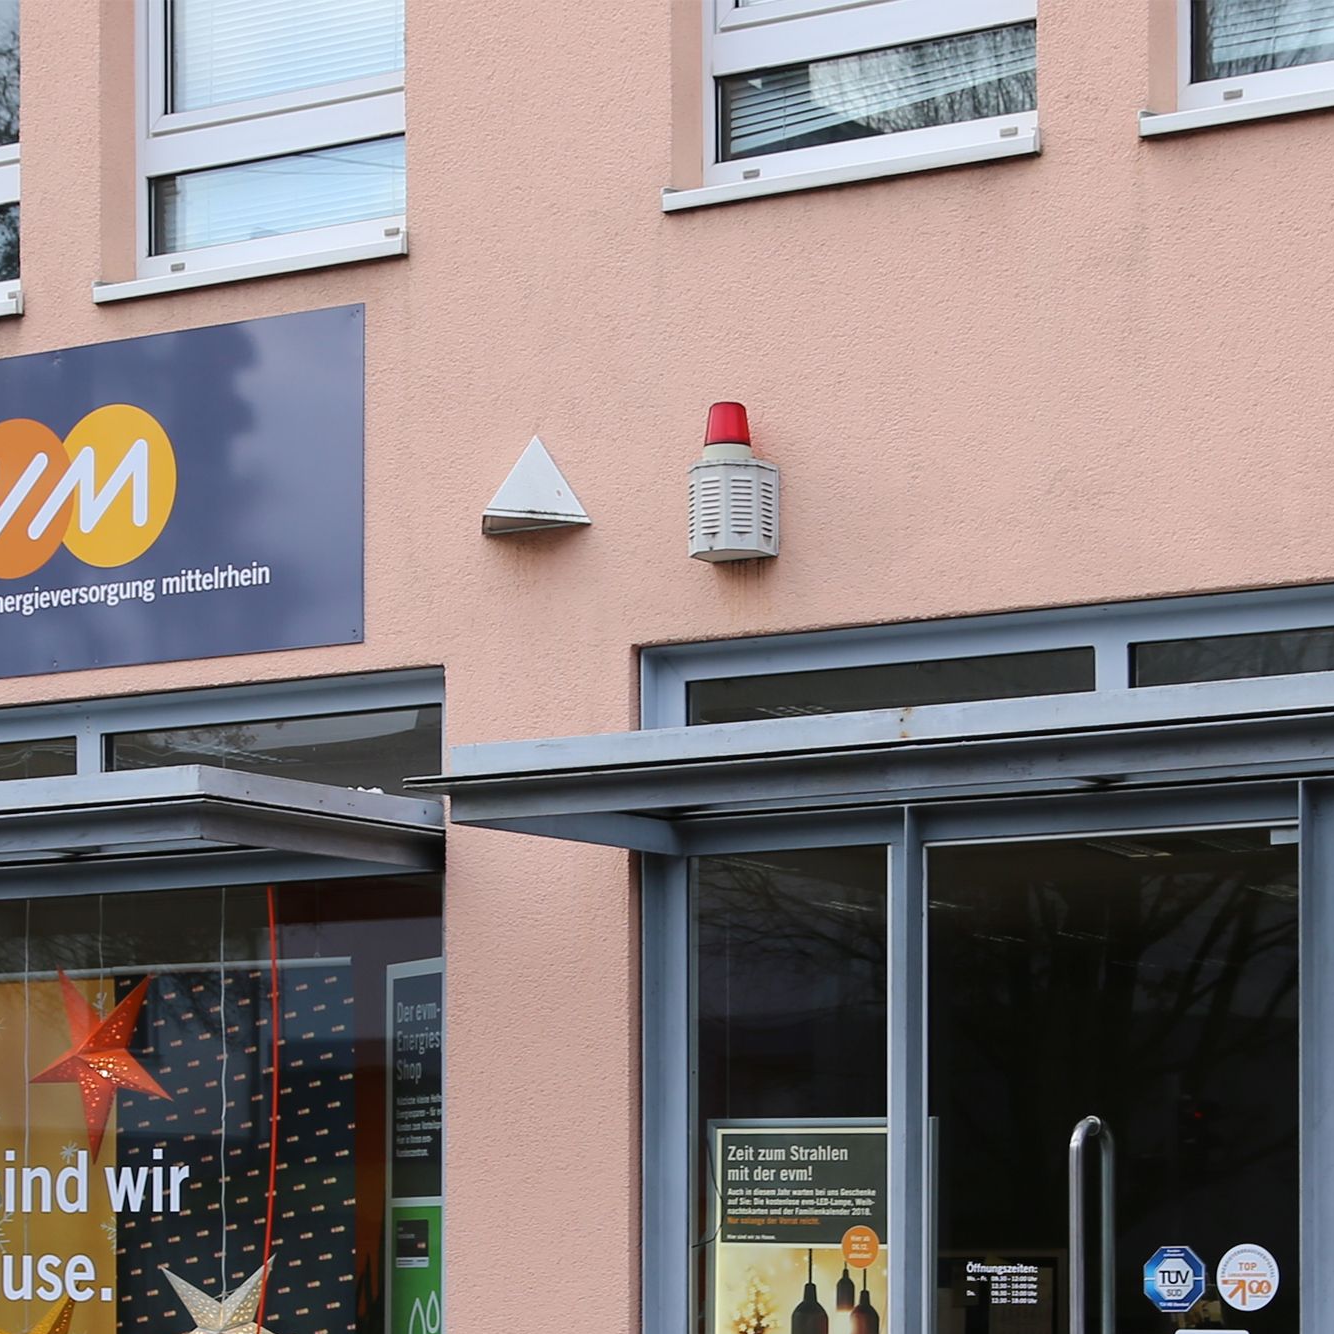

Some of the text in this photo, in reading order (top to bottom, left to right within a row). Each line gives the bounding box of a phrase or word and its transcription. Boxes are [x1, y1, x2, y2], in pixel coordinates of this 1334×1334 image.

[162, 561, 270, 595] mittelrhein
[397, 1002, 414, 1023] Der
[396, 1027, 442, 1054] Energies
[396, 1059, 422, 1084] Shop
[727, 1145, 848, 1161] Zeit zum Strahlen
[104, 1148, 190, 1213] wir
[727, 1165, 813, 1181] mit der evm!
[966, 1261, 1038, 1275] Öffnungszeiten:
[1238, 1262, 1257, 1271] TOP
[1159, 1269, 1189, 1284] TÜV
